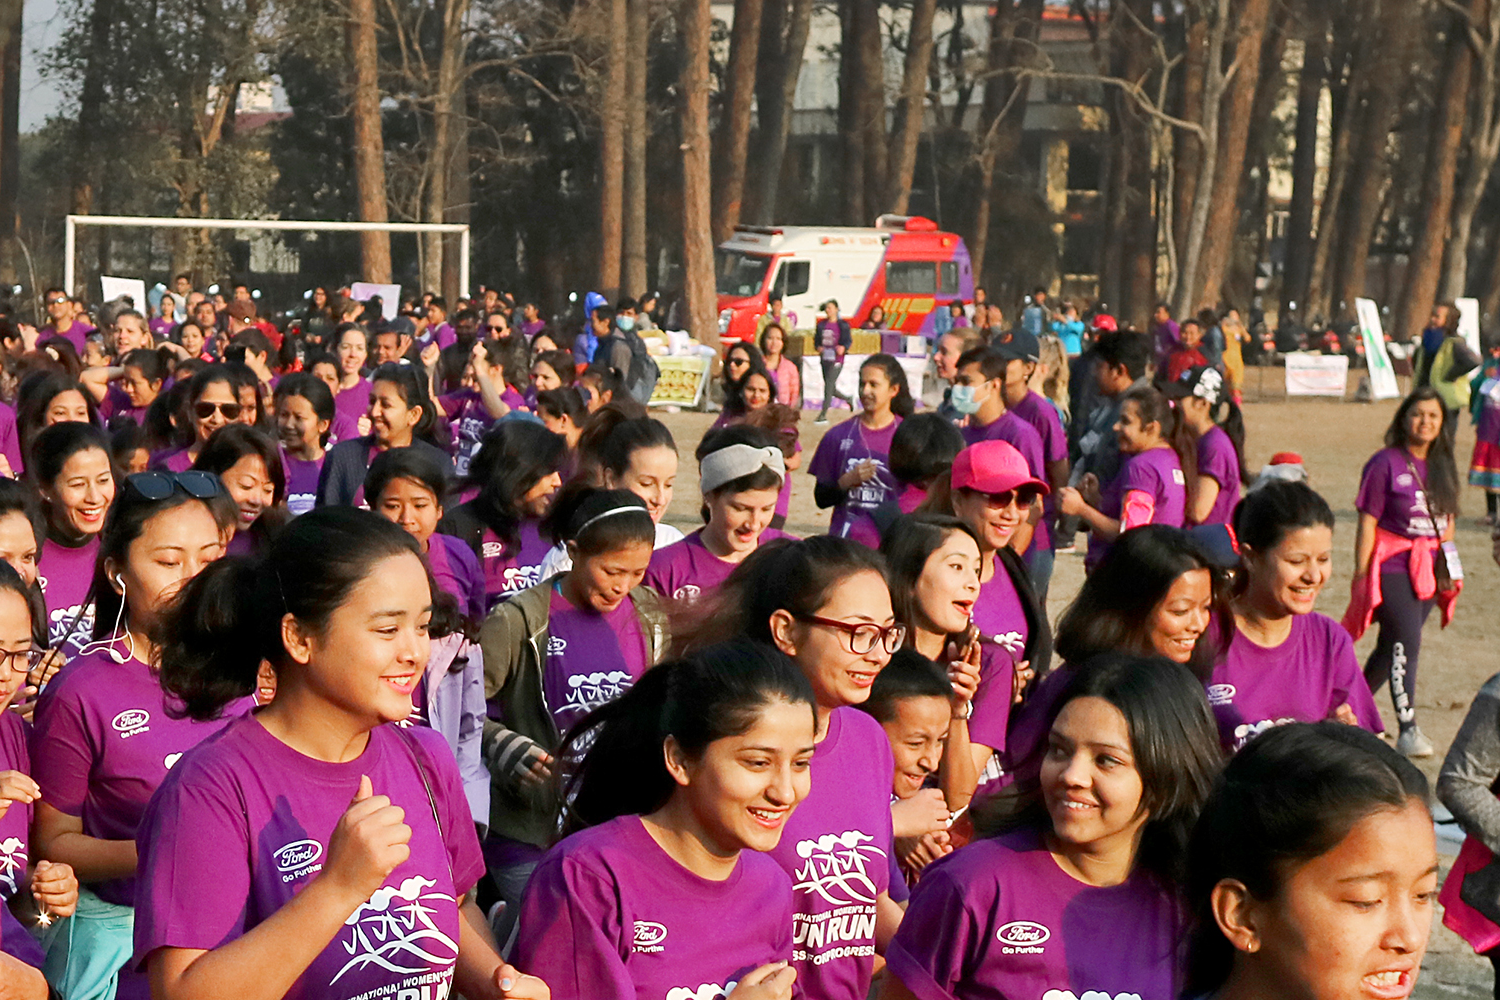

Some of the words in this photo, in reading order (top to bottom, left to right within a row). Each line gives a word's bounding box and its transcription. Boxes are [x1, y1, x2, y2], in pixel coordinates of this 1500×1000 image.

[282, 873, 295, 883] Go
[294, 863, 322, 879] Further
[793, 921, 826, 949] UN
[826, 913, 876, 945] RUN
[1001, 946, 1015, 955] Go
[1015, 945, 1045, 954] Further
